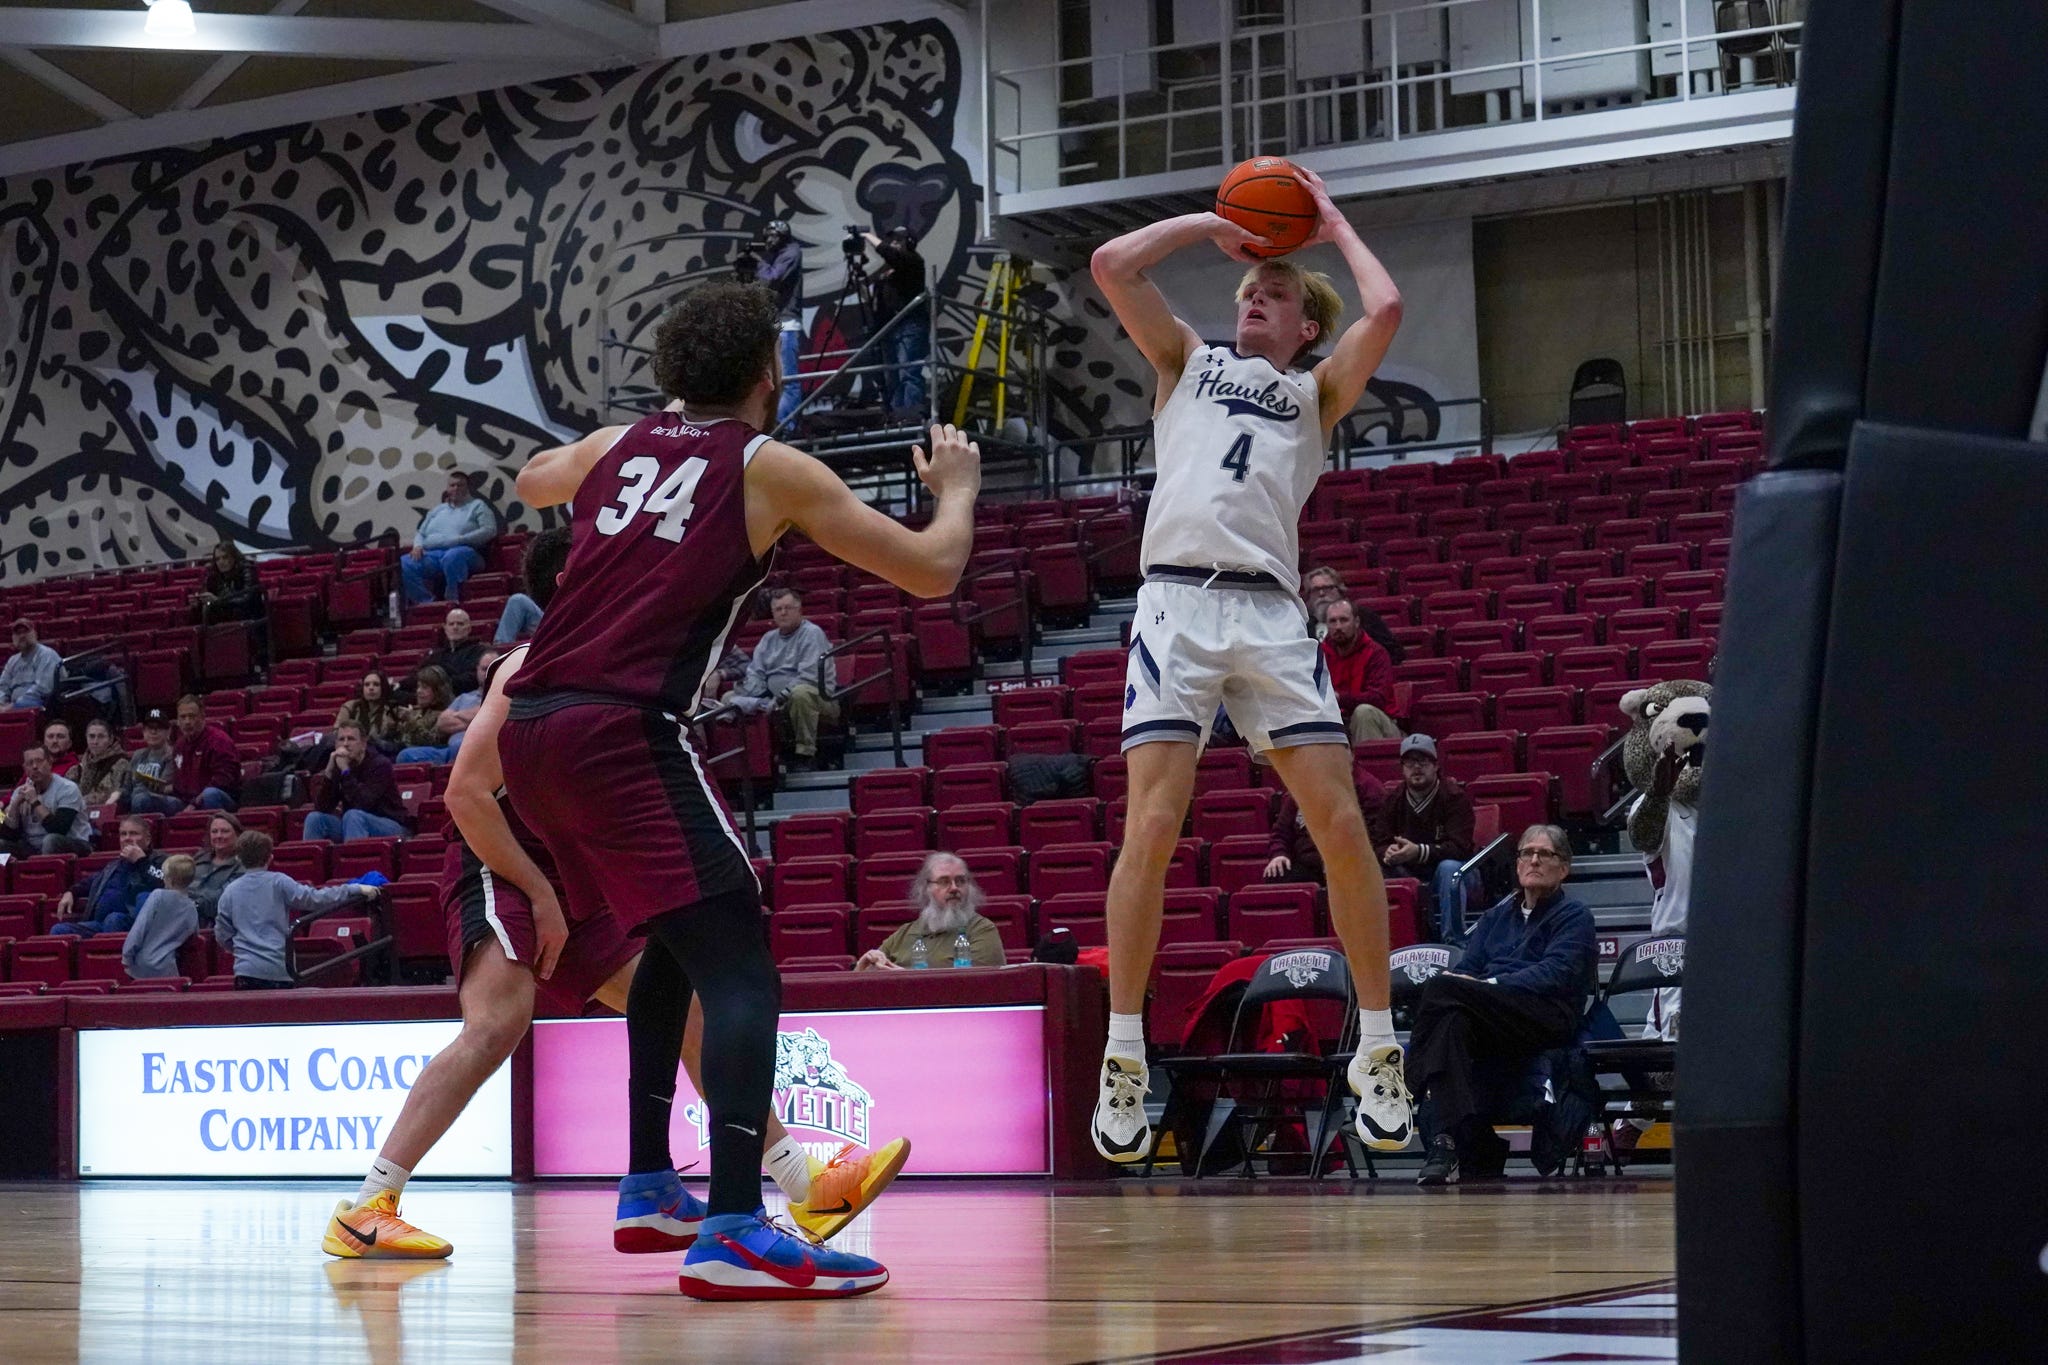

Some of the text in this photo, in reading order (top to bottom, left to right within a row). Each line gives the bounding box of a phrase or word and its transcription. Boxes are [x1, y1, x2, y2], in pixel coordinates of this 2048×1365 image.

[1195, 369, 1288, 413] Hawks
[1220, 432, 1255, 483] 4
[595, 456, 709, 543] 34
[1273, 954, 1329, 971] LAFAYETTE
[1390, 950, 1449, 968] LAFAYETTE
[1598, 941, 1616, 955] 13
[1638, 941, 1685, 959] LAFAYET
[141, 1052, 290, 1094] EASTON
[200, 1108, 383, 1152] COMPANY
